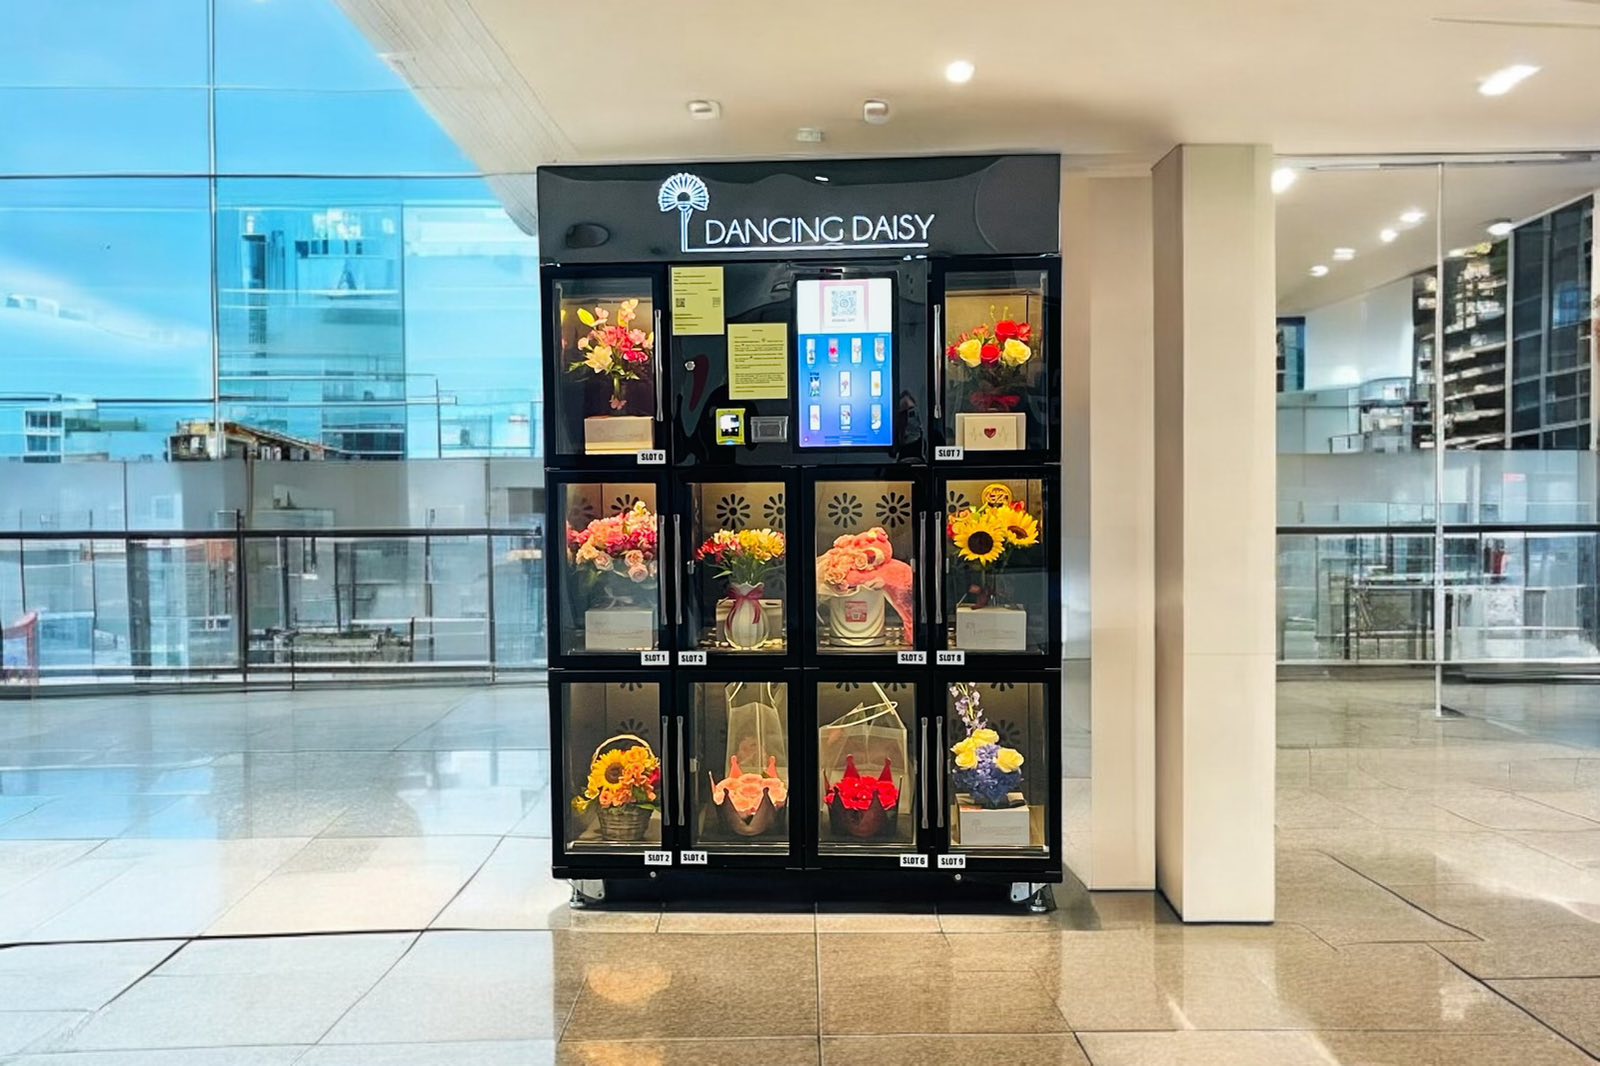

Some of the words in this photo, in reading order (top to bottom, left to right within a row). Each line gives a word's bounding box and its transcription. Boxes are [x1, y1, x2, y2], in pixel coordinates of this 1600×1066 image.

[705, 217, 844, 245] DANCING
[852, 213, 935, 242] DAISY
[641, 453, 657, 461] SLOT
[938, 449, 955, 457] SLOT
[644, 654, 660, 662] SLOT
[681, 654, 697, 662] SLOT
[648, 854, 664, 862] SLOT
[683, 853, 699, 861] SLOT
[902, 856, 919, 864] SLOT
[941, 857, 957, 865] SLOT
